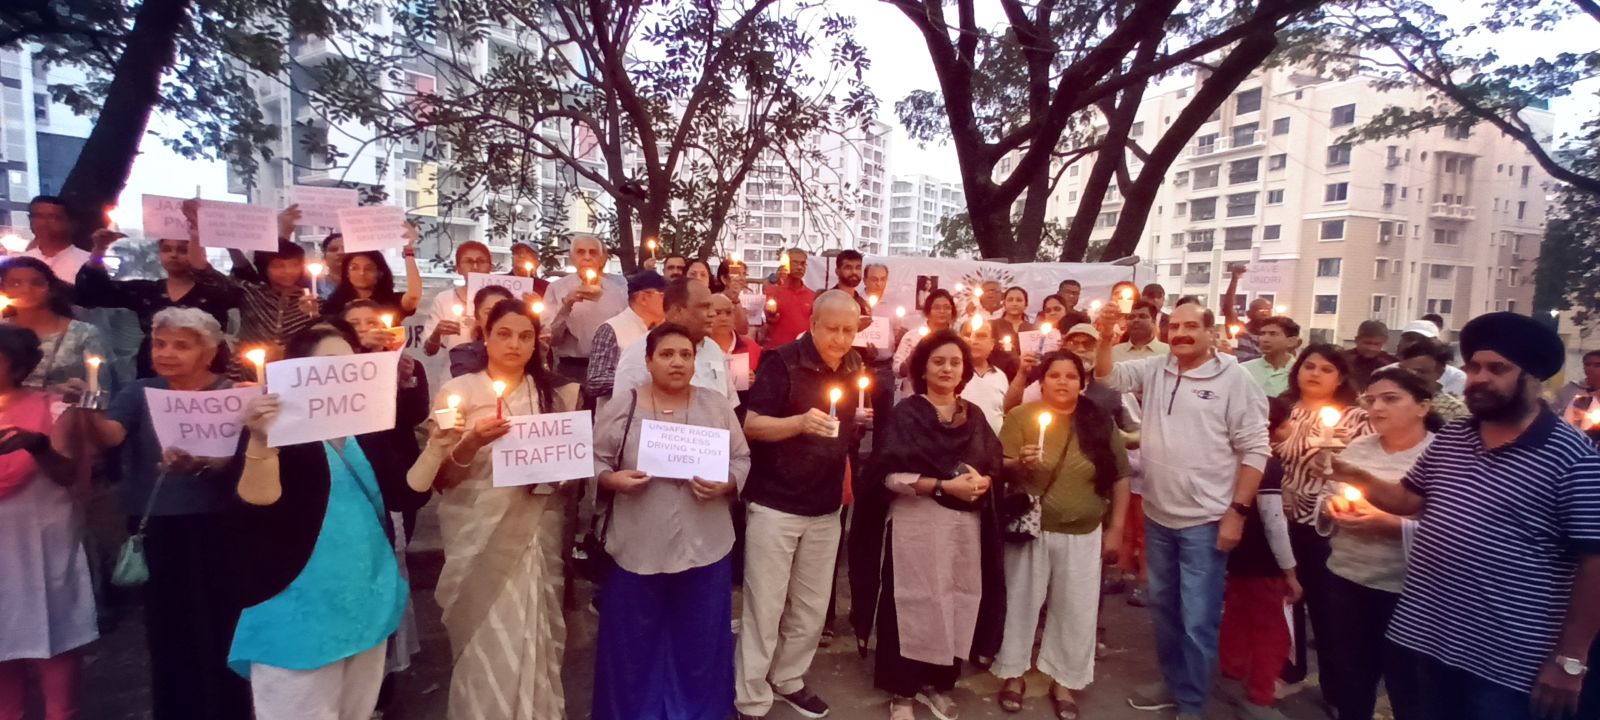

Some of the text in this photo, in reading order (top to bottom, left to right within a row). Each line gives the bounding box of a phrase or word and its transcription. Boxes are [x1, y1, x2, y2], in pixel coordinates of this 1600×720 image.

[154, 200, 183, 210] JAA
[164, 216, 186, 229] PM
[290, 361, 377, 388] JAAGO
[164, 395, 242, 414] JAAGO
[308, 393, 366, 419] PMC
[180, 423, 238, 439] PMC
[514, 419, 573, 440] TAME
[649, 423, 687, 434] UNSAFE
[661, 433, 711, 447] RECKLESS
[501, 442, 587, 467] TRAFFIC
[647, 440, 687, 452] DRIVING
[699, 448, 722, 457] LOST
[667, 454, 695, 464] LIVES
